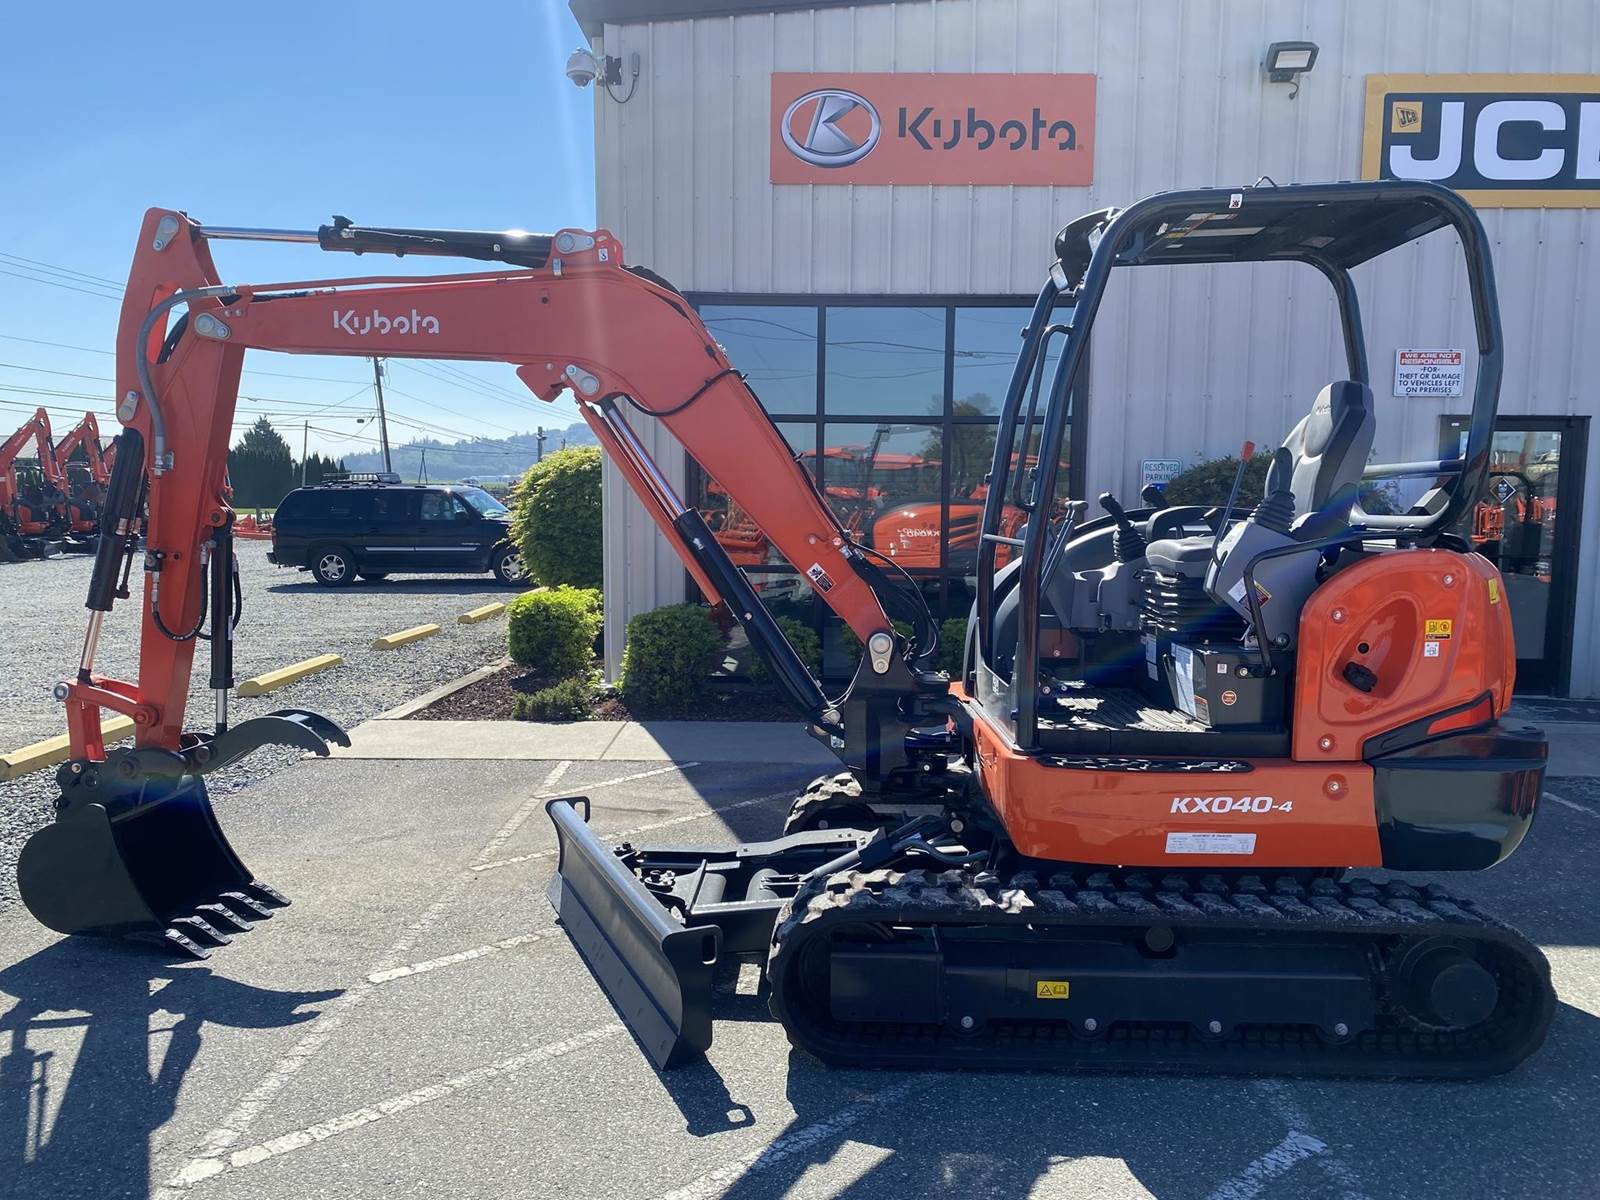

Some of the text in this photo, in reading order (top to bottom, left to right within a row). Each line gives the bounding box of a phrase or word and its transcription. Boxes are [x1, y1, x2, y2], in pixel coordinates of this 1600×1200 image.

[1400, 109, 1417, 125] JCB
[898, 107, 1077, 151] Kubota
[1389, 100, 1600, 181] JC
[333, 309, 440, 335] Kubota
[1145, 463, 1178, 472] RESERVED
[1170, 796, 1293, 813] KX040-4
